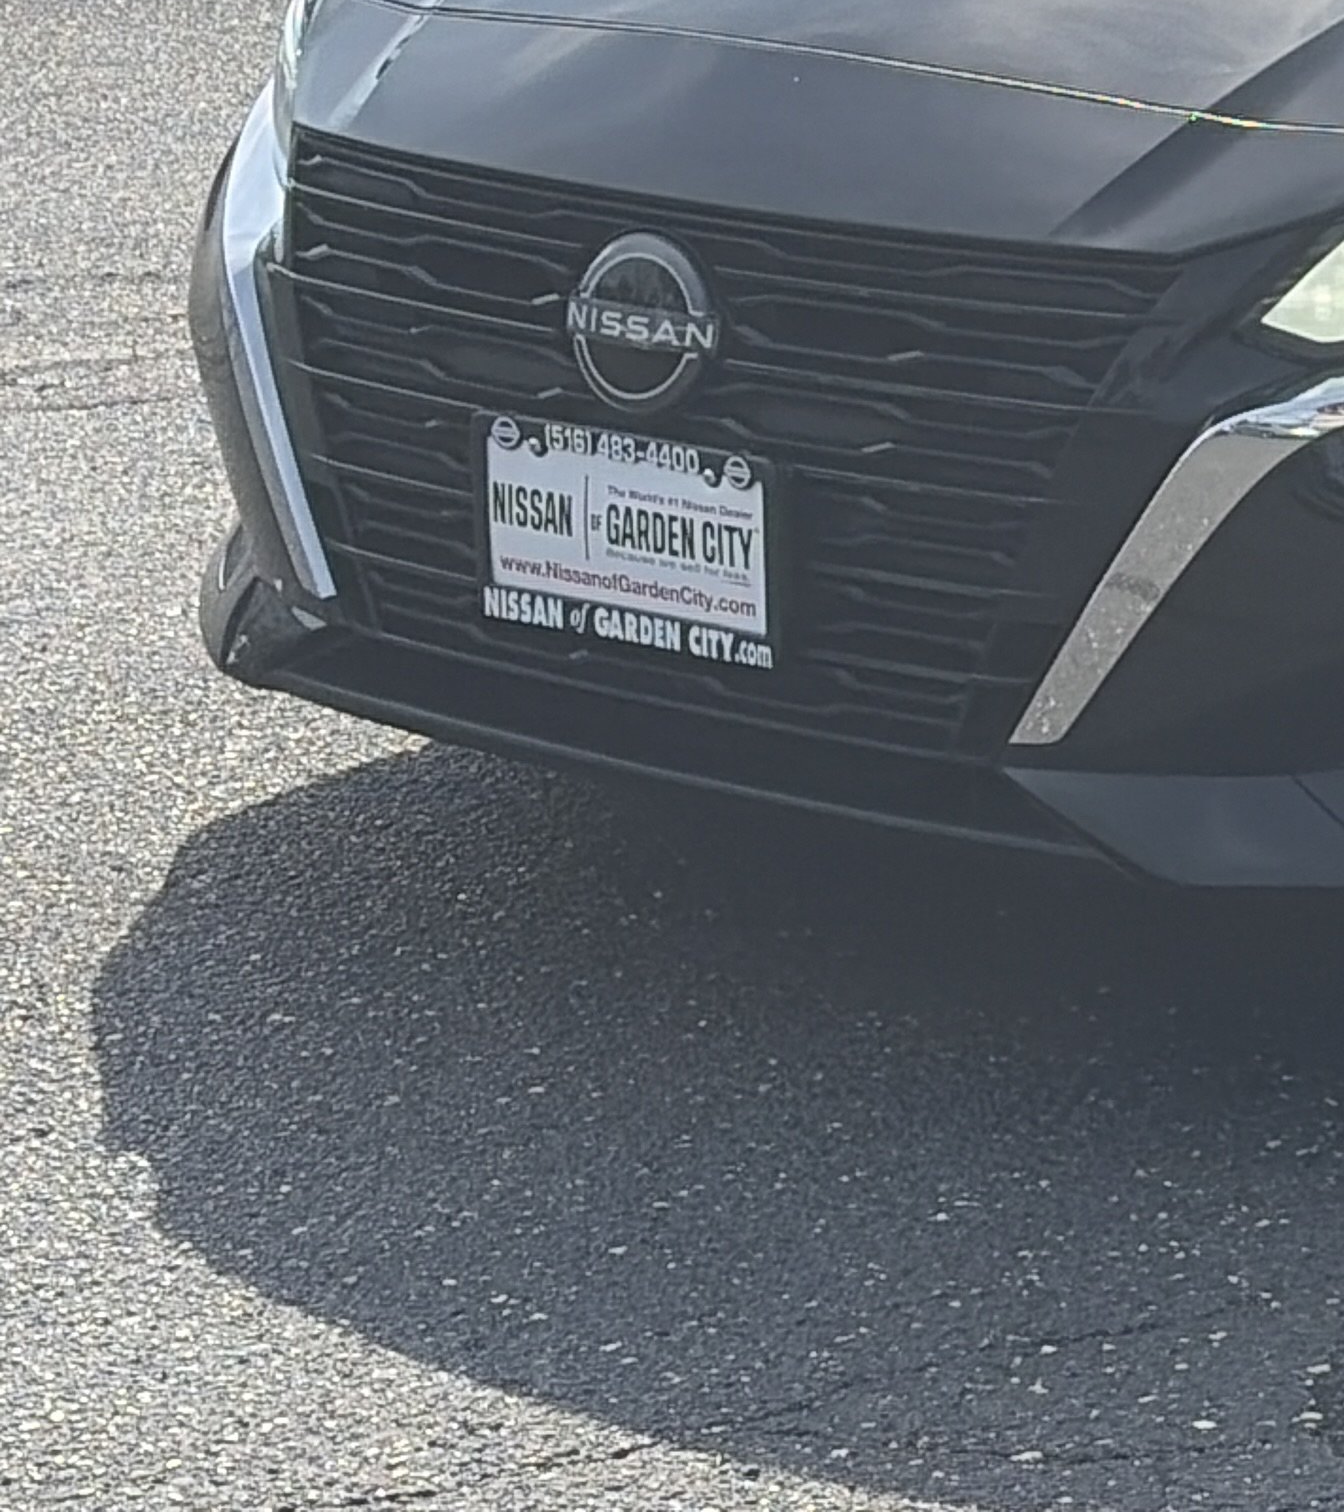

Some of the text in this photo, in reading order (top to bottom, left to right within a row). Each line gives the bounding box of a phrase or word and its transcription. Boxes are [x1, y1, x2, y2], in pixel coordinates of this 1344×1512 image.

[567, 301, 713, 348] NISSAN
[544, 423, 699, 474] (516) 483-4400
[492, 481, 573, 538] NISSAN
[606, 503, 696, 560] GARDEN
[702, 521, 753, 570] CITY
[500, 555, 756, 617] www.NissanofGardenCity.com
[484, 586, 774, 669] NISSAN of GARDEN CITY.com
